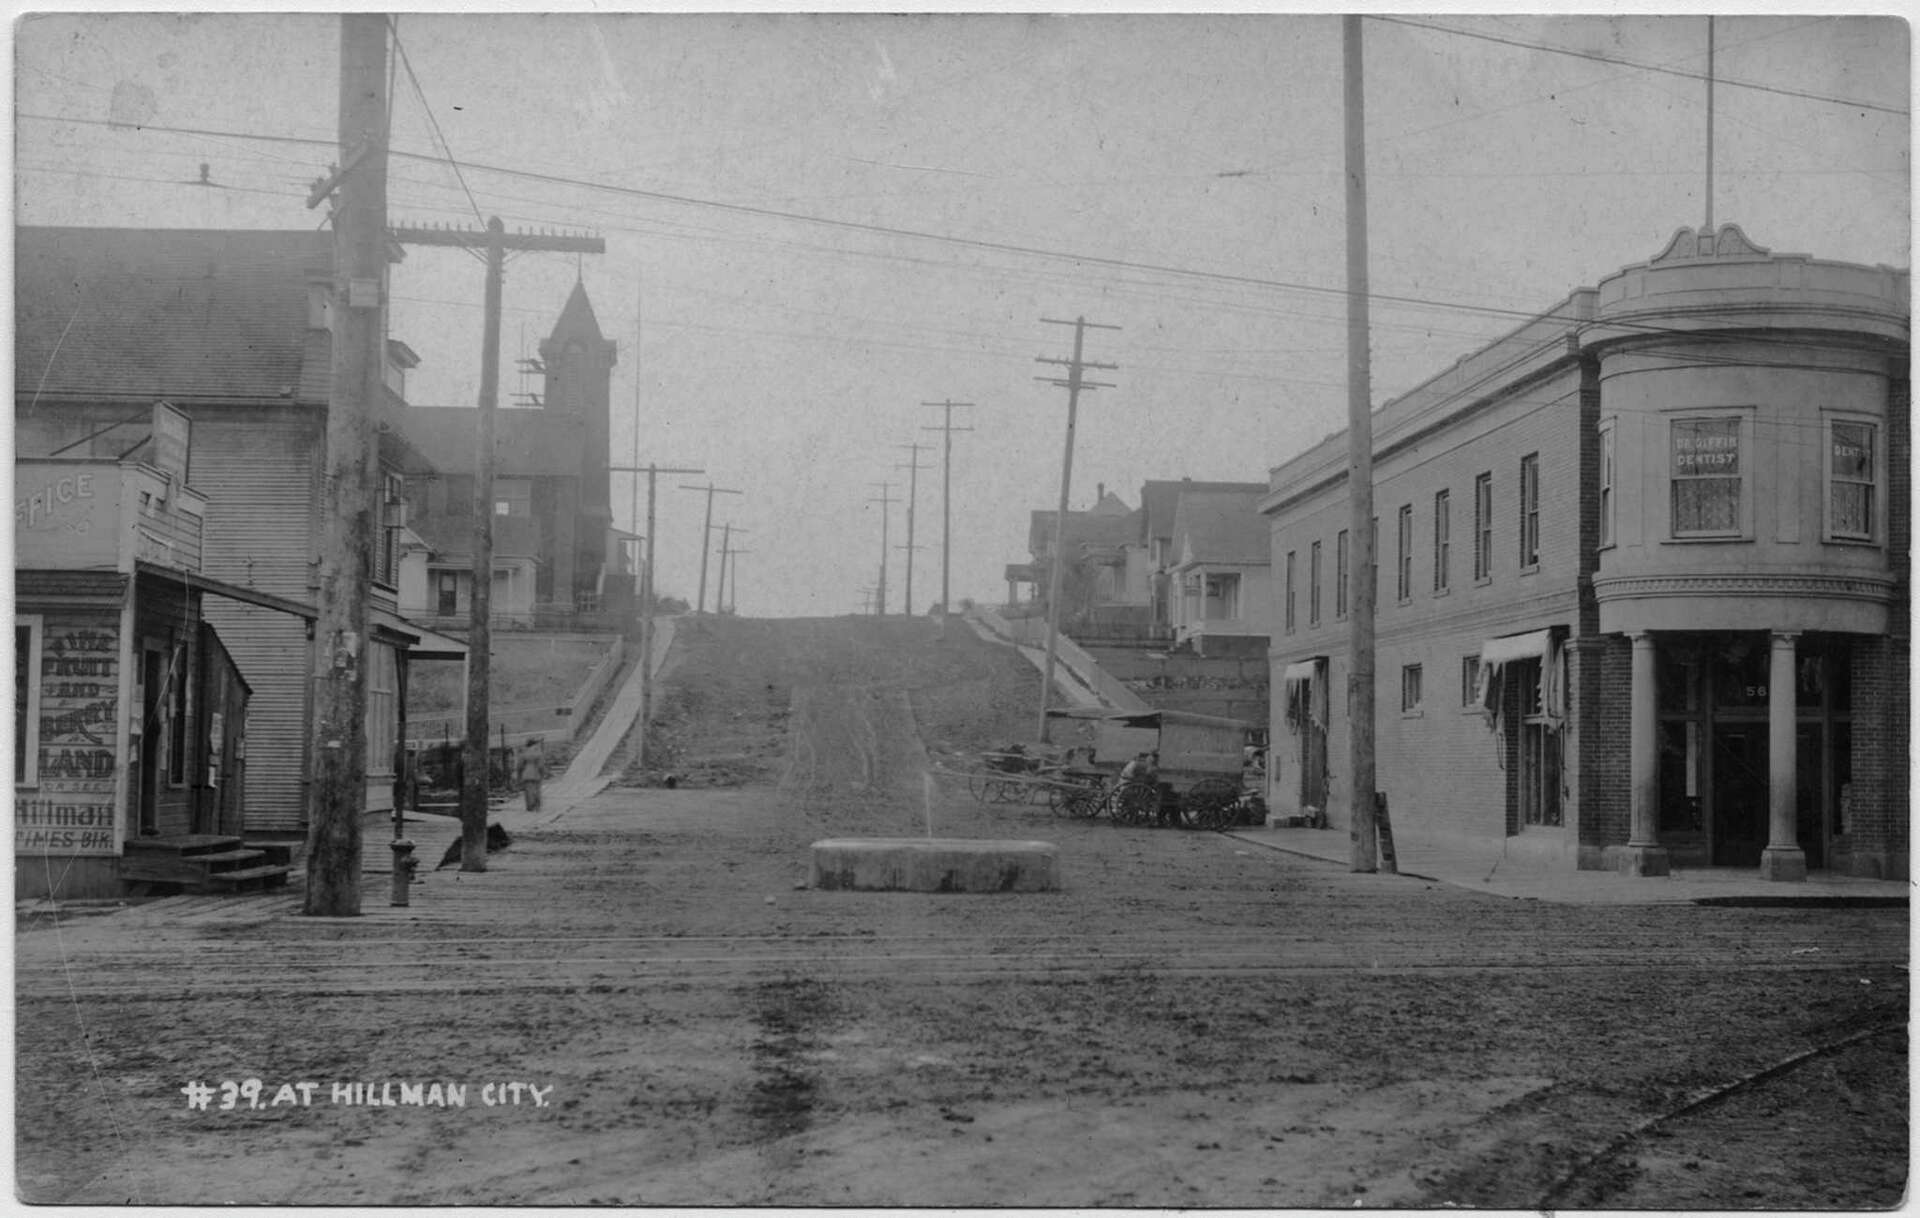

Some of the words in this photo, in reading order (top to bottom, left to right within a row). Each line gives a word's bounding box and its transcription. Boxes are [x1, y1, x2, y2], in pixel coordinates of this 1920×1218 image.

[1677, 453, 1736, 466] DENTIST
[42, 657, 115, 677] FRUIT
[40, 699, 118, 744] BERRY
[39, 748, 115, 777] LAND
